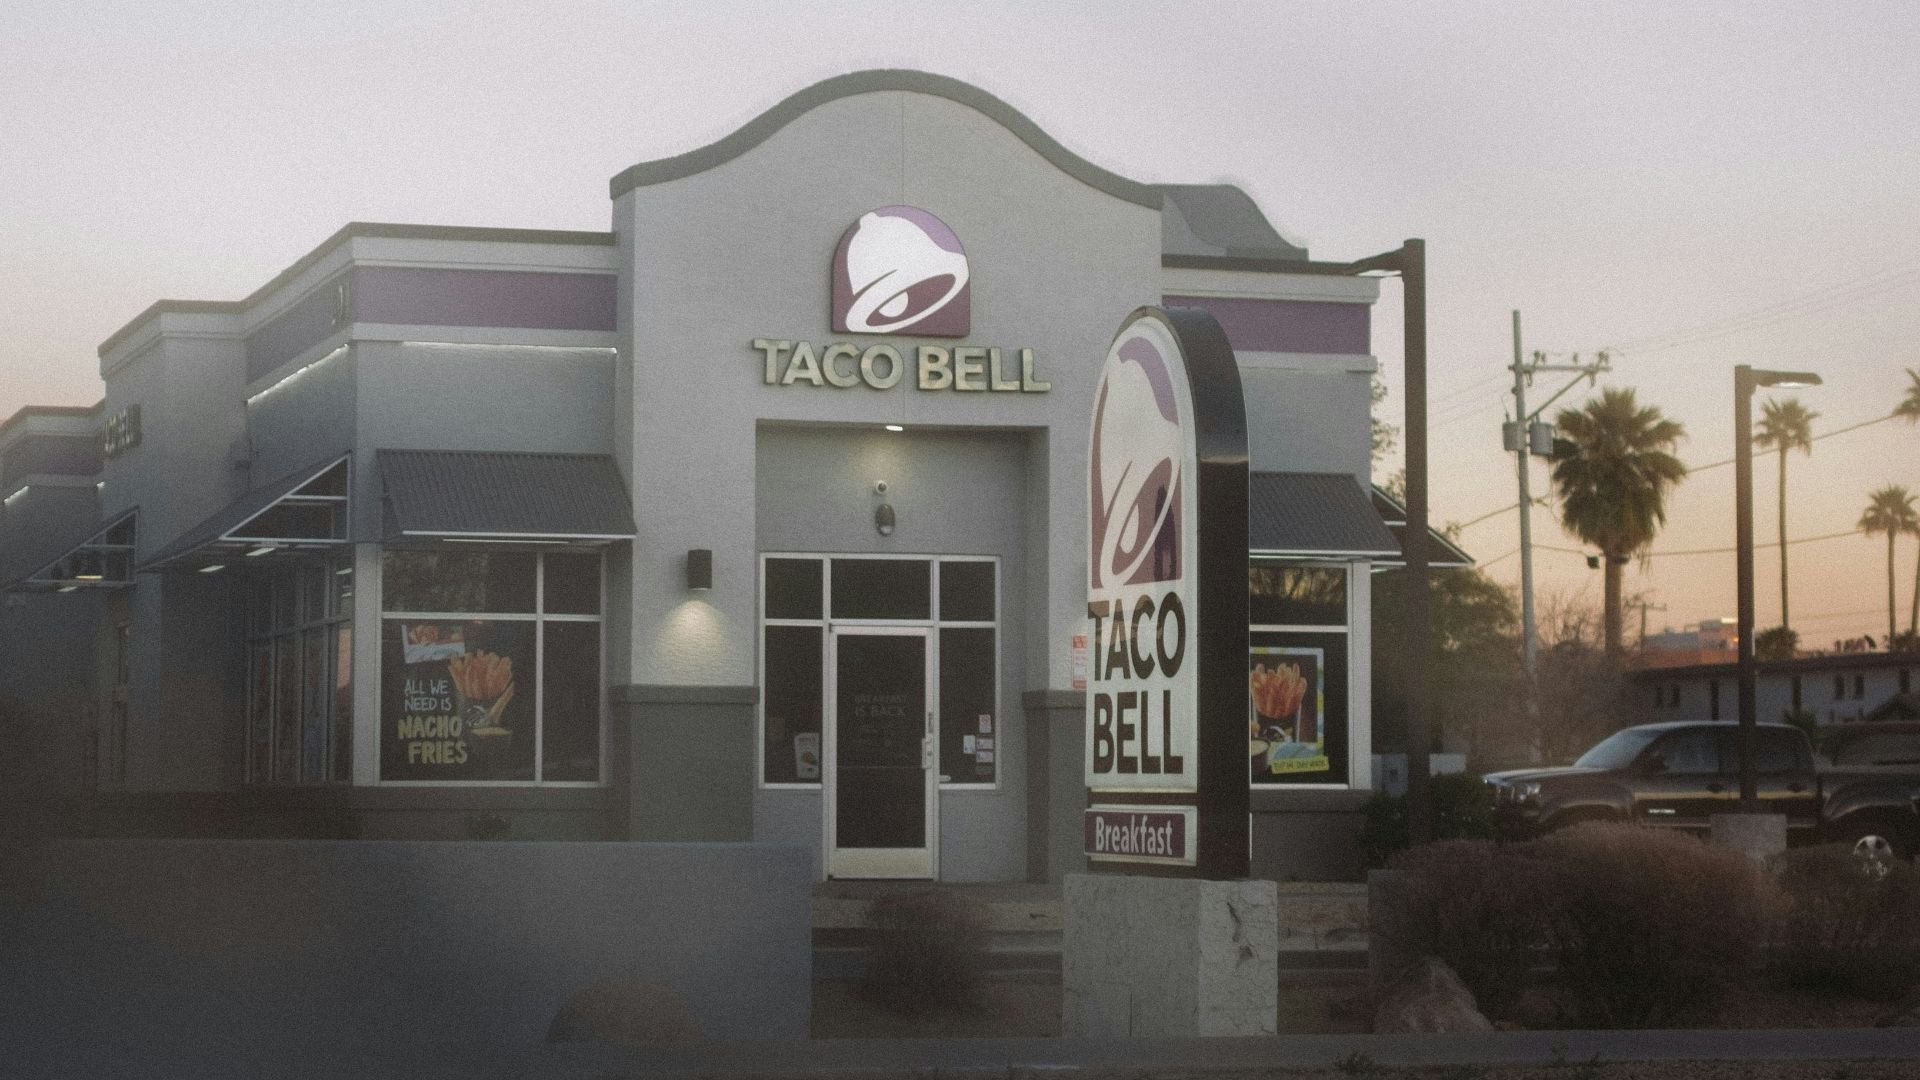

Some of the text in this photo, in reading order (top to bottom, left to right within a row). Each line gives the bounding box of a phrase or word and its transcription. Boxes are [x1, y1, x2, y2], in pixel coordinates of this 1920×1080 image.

[753, 338, 1052, 393] TACO BELL
[1088, 591, 1186, 681] TACO
[404, 679, 449, 696] ALL WE
[404, 697, 452, 711] NEED IS
[397, 714, 463, 739] NACHO
[1093, 690, 1184, 775] BELL
[408, 741, 468, 764] FRIES
[1095, 815, 1173, 855] Breakfast
